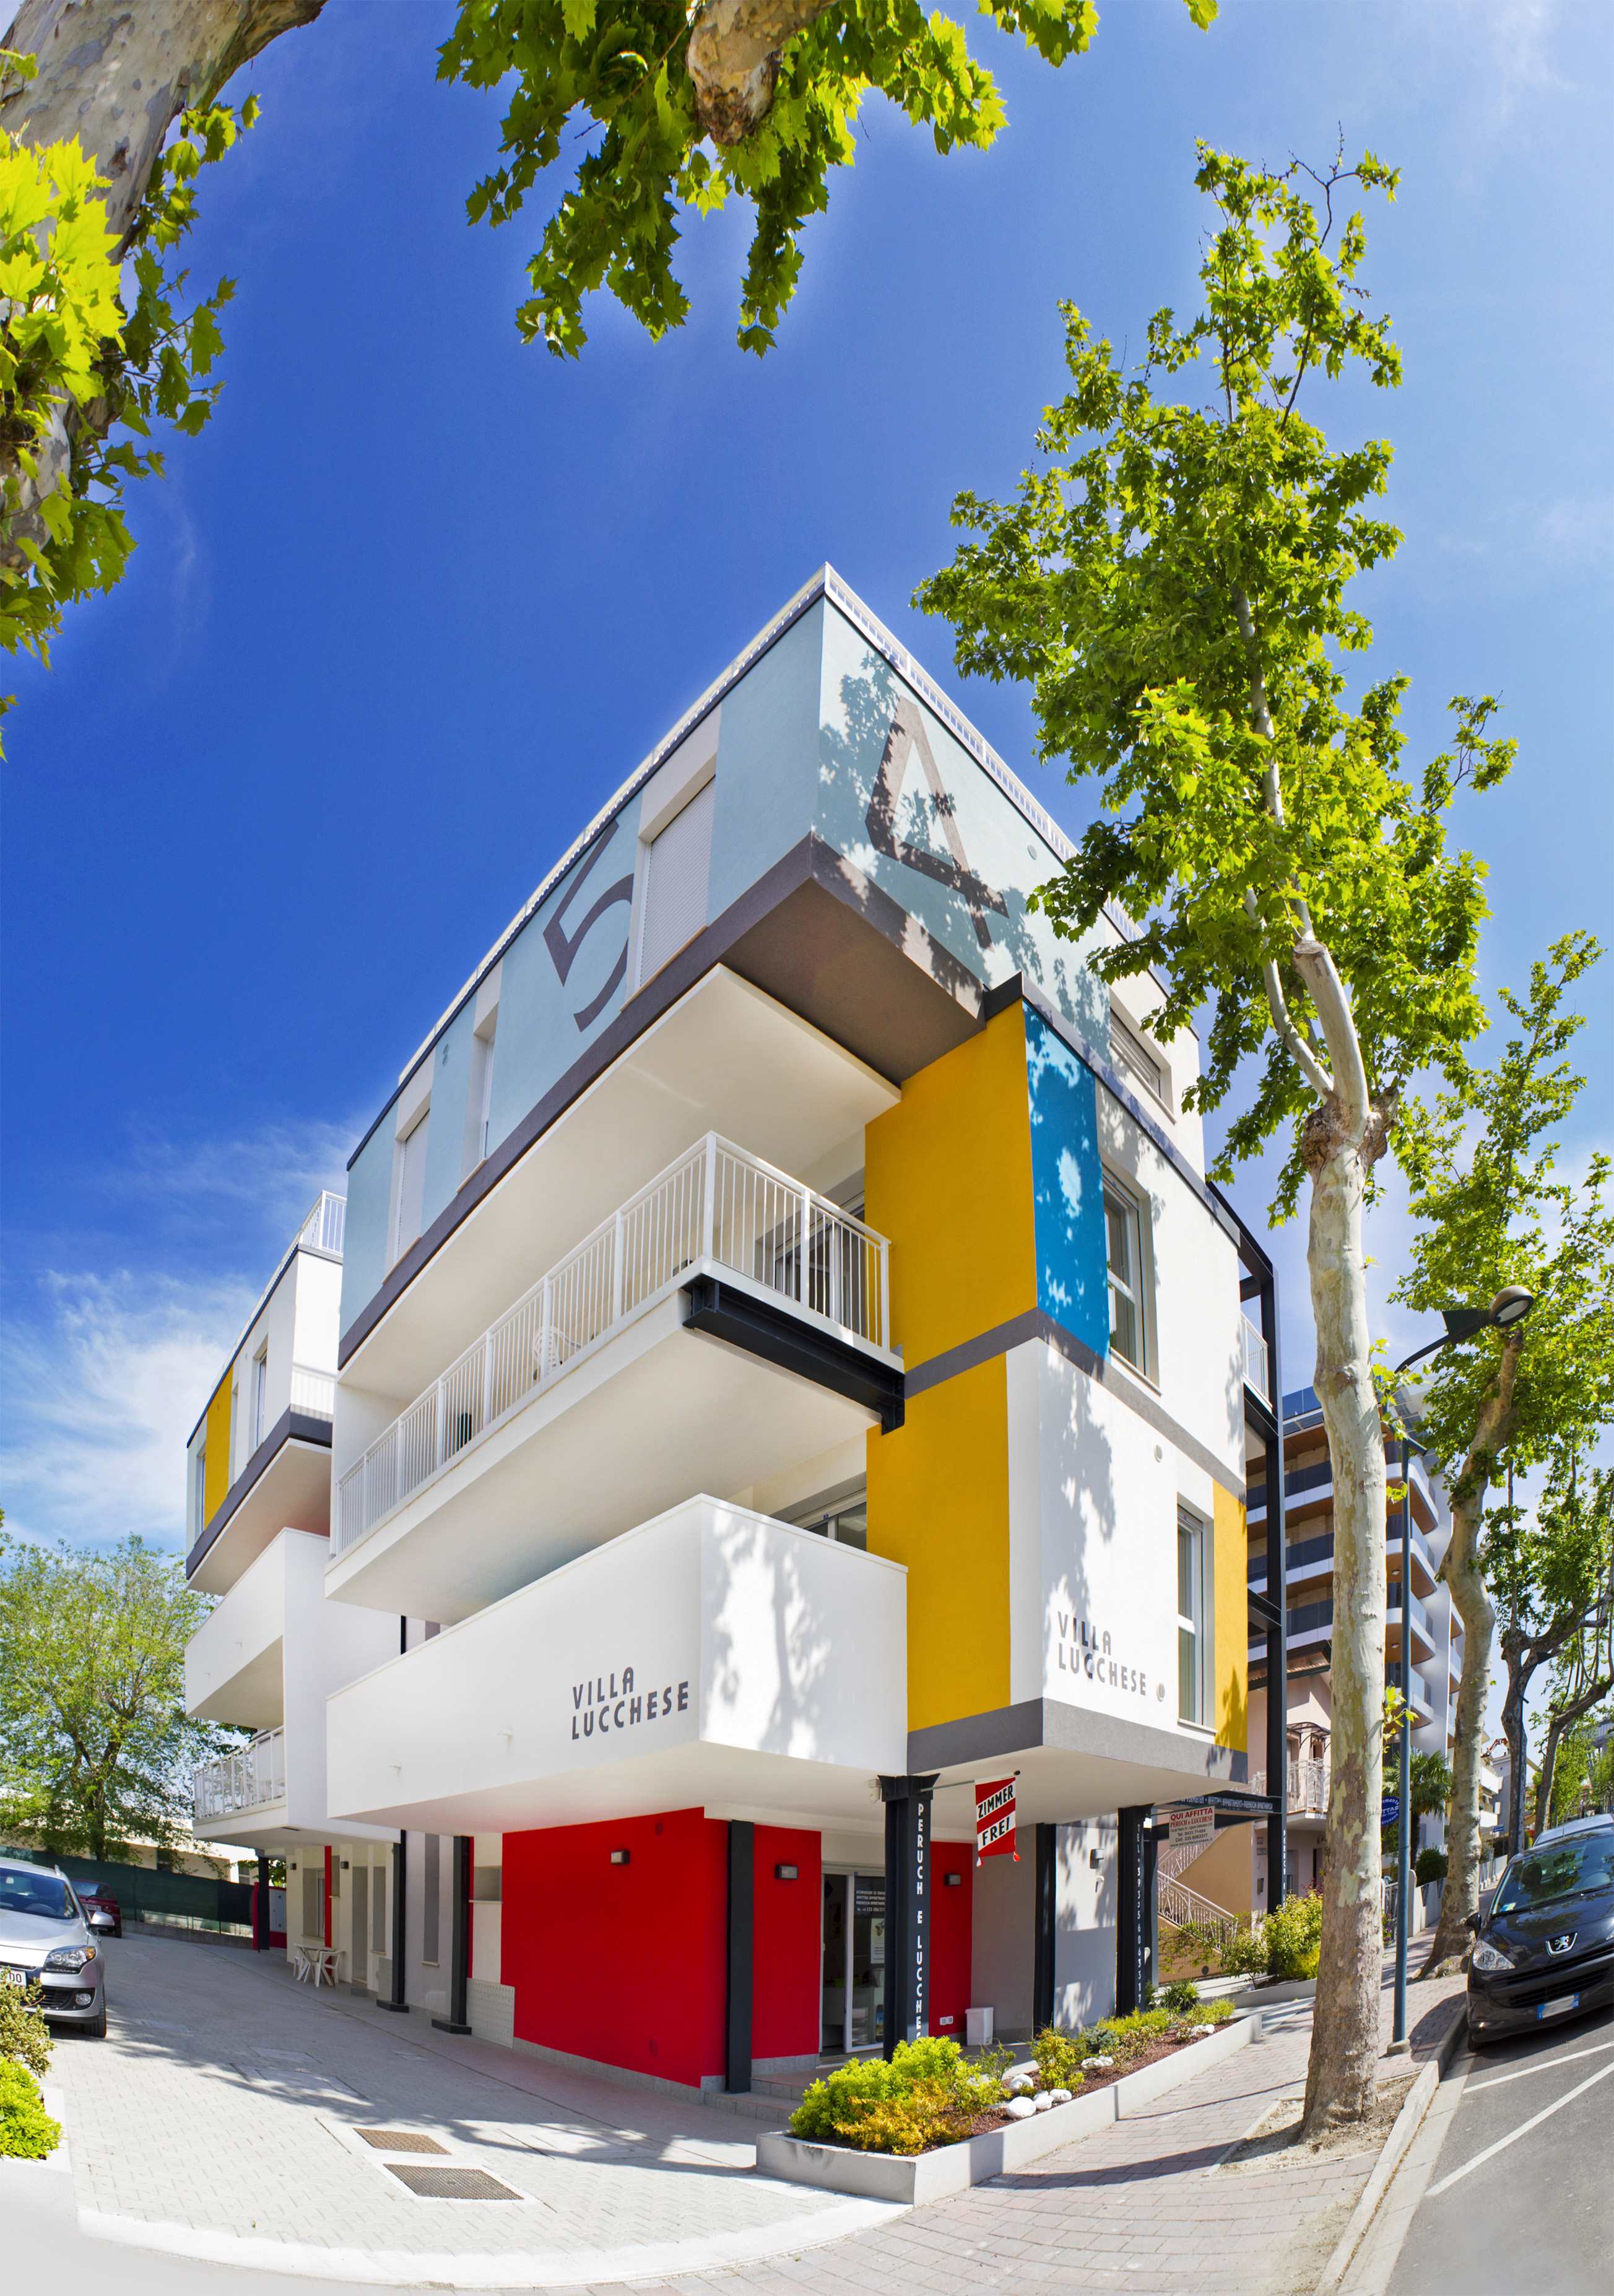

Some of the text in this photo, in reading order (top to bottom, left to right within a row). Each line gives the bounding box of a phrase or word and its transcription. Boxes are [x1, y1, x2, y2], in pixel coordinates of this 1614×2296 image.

[1057, 1611, 1111, 1656] VILLA
[572, 1666, 634, 1710] VILLA
[1058, 1642, 1146, 1696] LUCCHESE
[572, 1681, 689, 1740] LUCCHESE
[978, 1784, 1013, 1819] ZIMMER
[1170, 1808, 1213, 1821] QUI AFFITTA
[982, 1816, 1010, 1847] FREI
[1170, 1819, 1187, 1828] PERUCH
[1191, 1816, 1213, 1825] LUCCHESE
[916, 1803, 924, 1895] PERUCH
[917, 1910, 923, 1925] E
